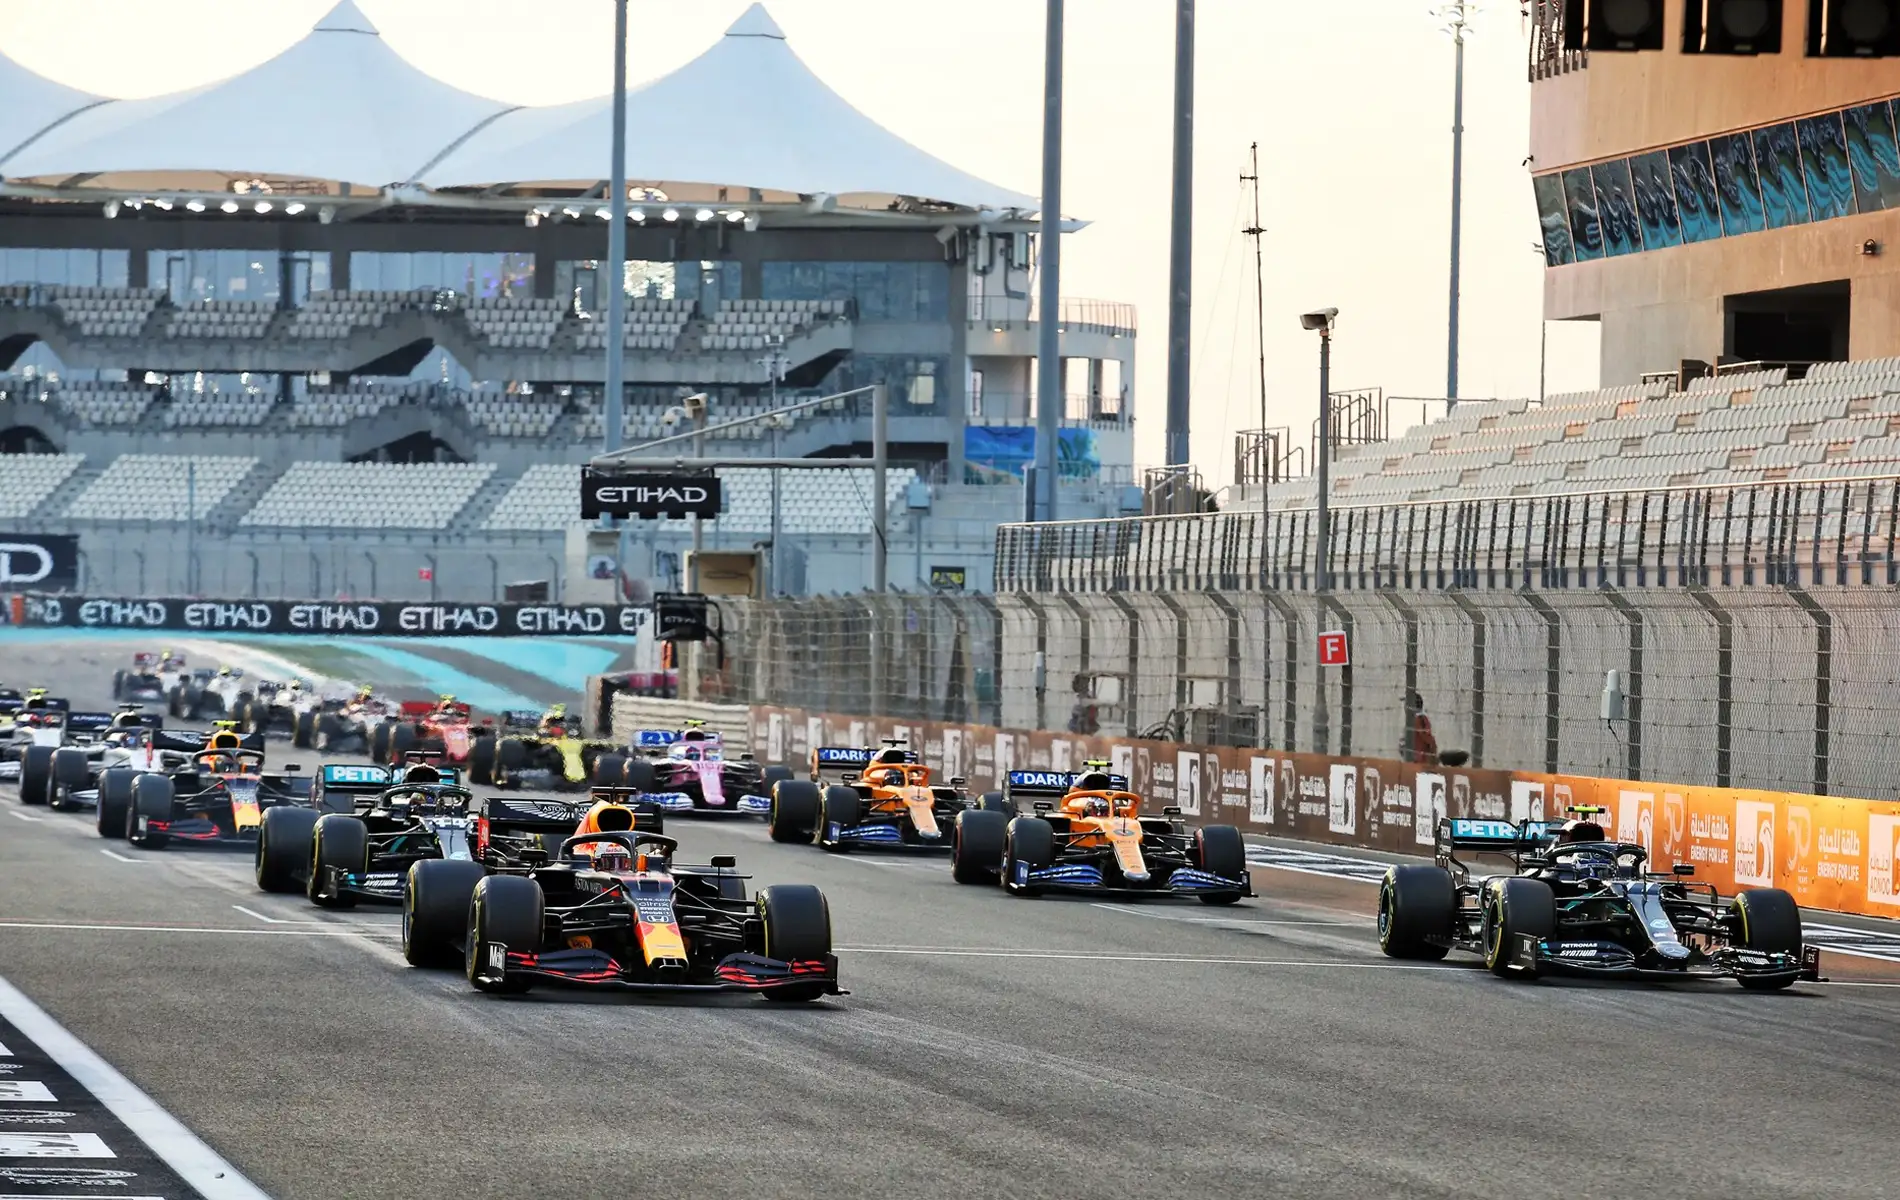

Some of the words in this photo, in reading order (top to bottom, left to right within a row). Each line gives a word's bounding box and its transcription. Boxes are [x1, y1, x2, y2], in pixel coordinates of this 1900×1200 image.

[596, 487, 706, 503] ETIHAD
[79, 600, 166, 625] ETIHAD
[184, 602, 272, 628] ETIHAD
[289, 604, 379, 630] ETIHAD
[399, 606, 498, 631] ETIHAD
[516, 607, 605, 631] ETIHAD
[1326, 638, 1339, 661] F
